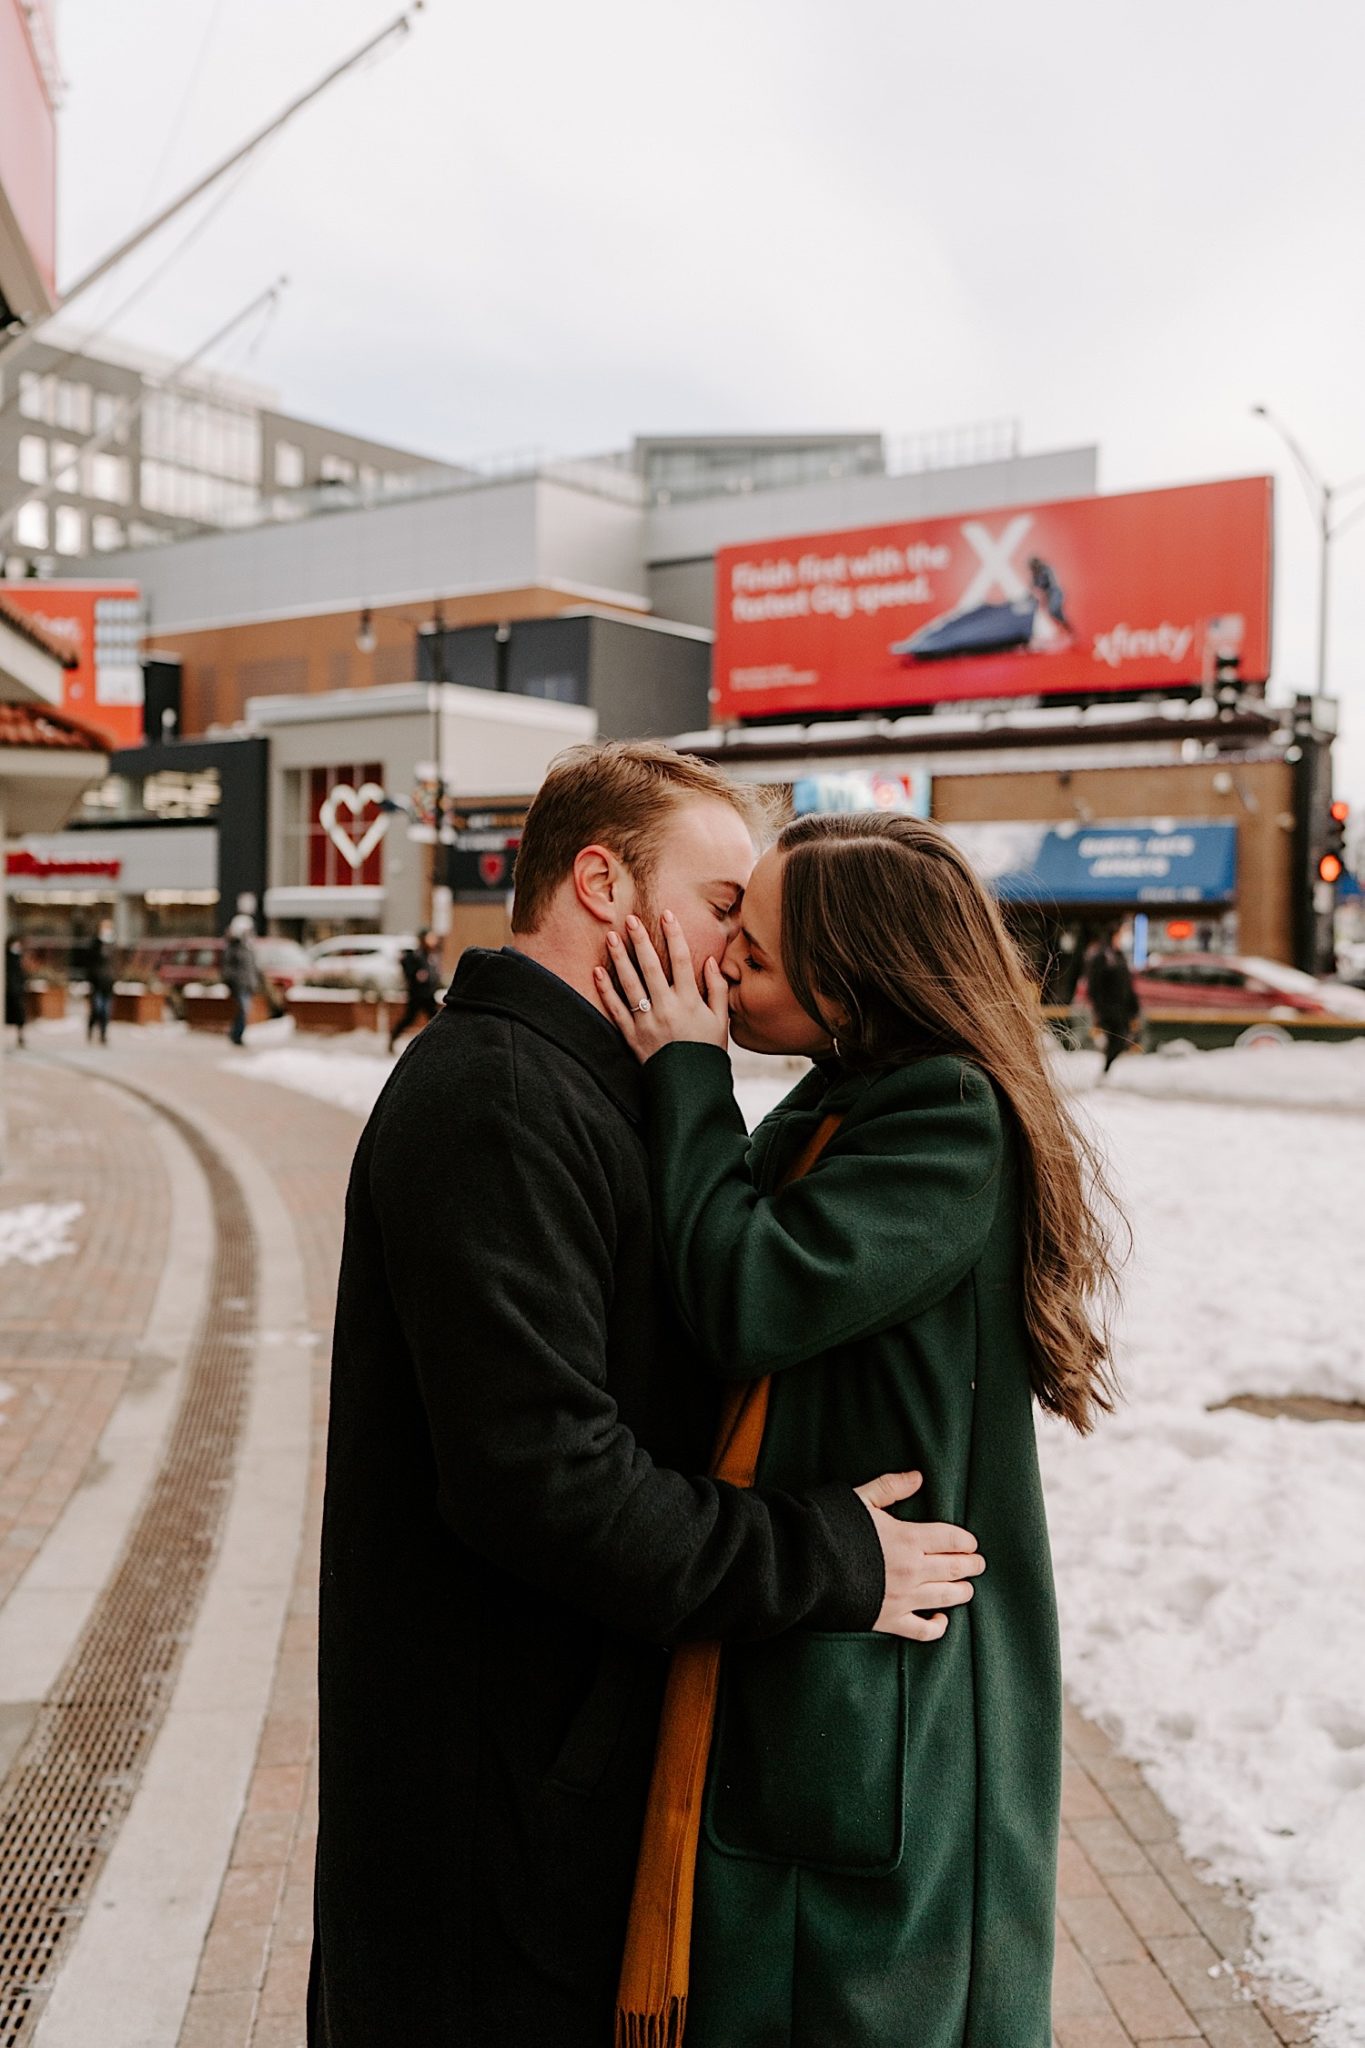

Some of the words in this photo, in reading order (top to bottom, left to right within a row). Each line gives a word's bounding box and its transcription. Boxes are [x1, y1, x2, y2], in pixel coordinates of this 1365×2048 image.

[732, 561, 796, 592] Finish
[798, 555, 845, 582] first
[849, 547, 901, 578] with
[906, 542, 948, 572] the
[732, 588, 809, 623] fastest
[811, 581, 853, 619] Gig
[1093, 622, 1191, 668] xfinity
